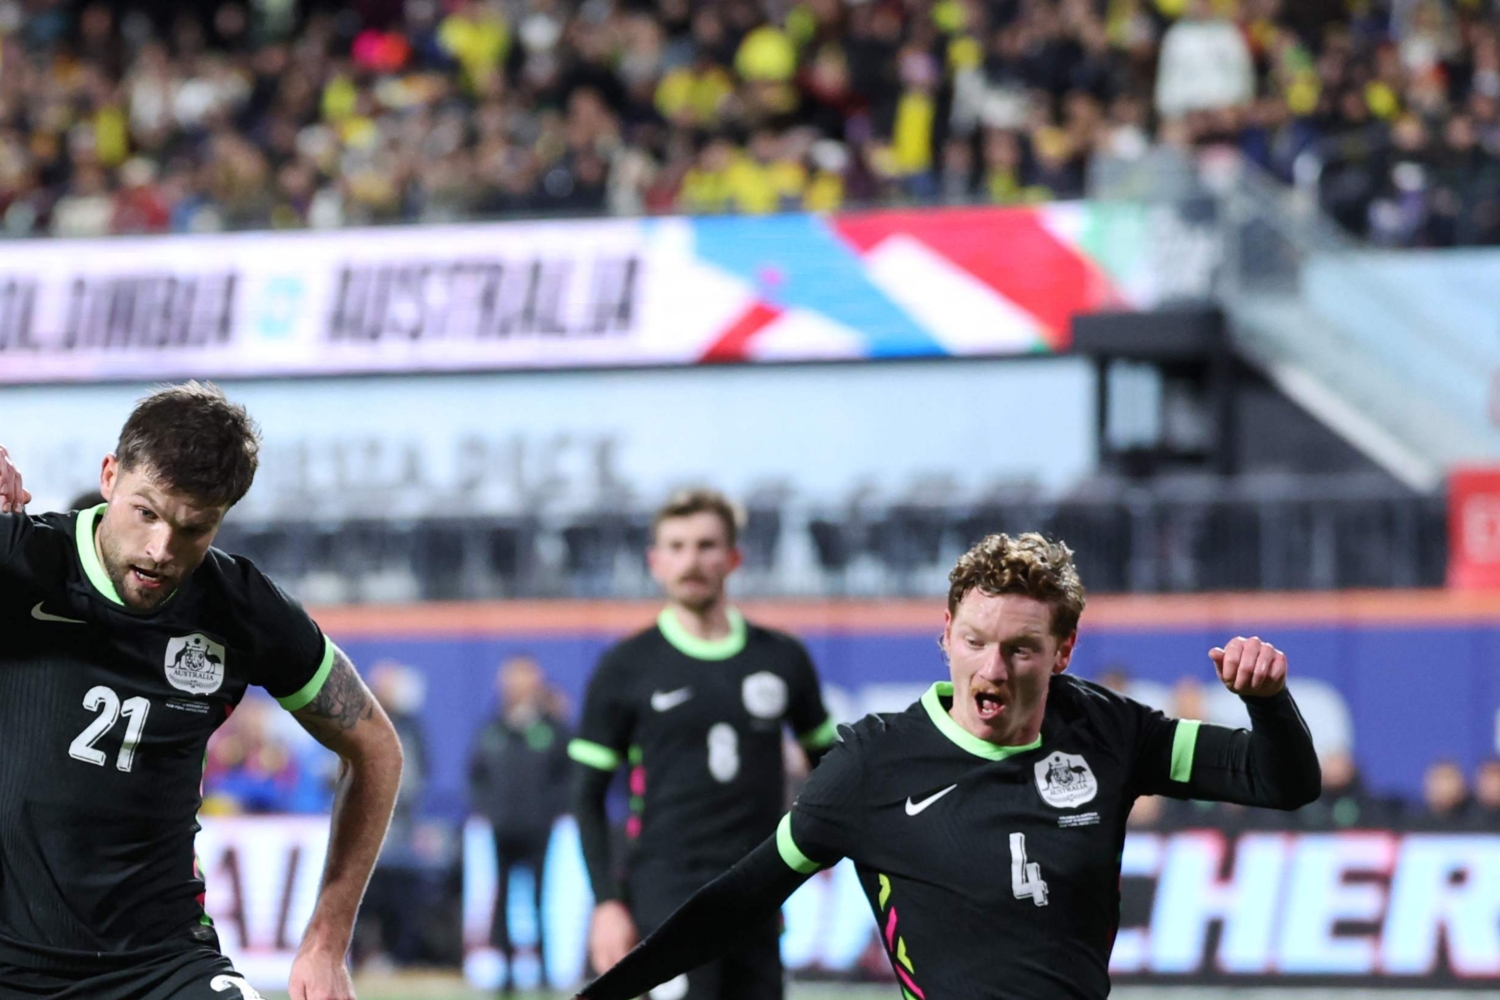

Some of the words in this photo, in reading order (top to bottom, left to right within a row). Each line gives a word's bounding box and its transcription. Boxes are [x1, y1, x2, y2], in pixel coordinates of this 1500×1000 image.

[329, 256, 641, 342] AUSTRALIA
[173, 669, 214, 681] AUSTRALIA
[69, 685, 151, 773] 21
[1009, 832, 1049, 907] 4
